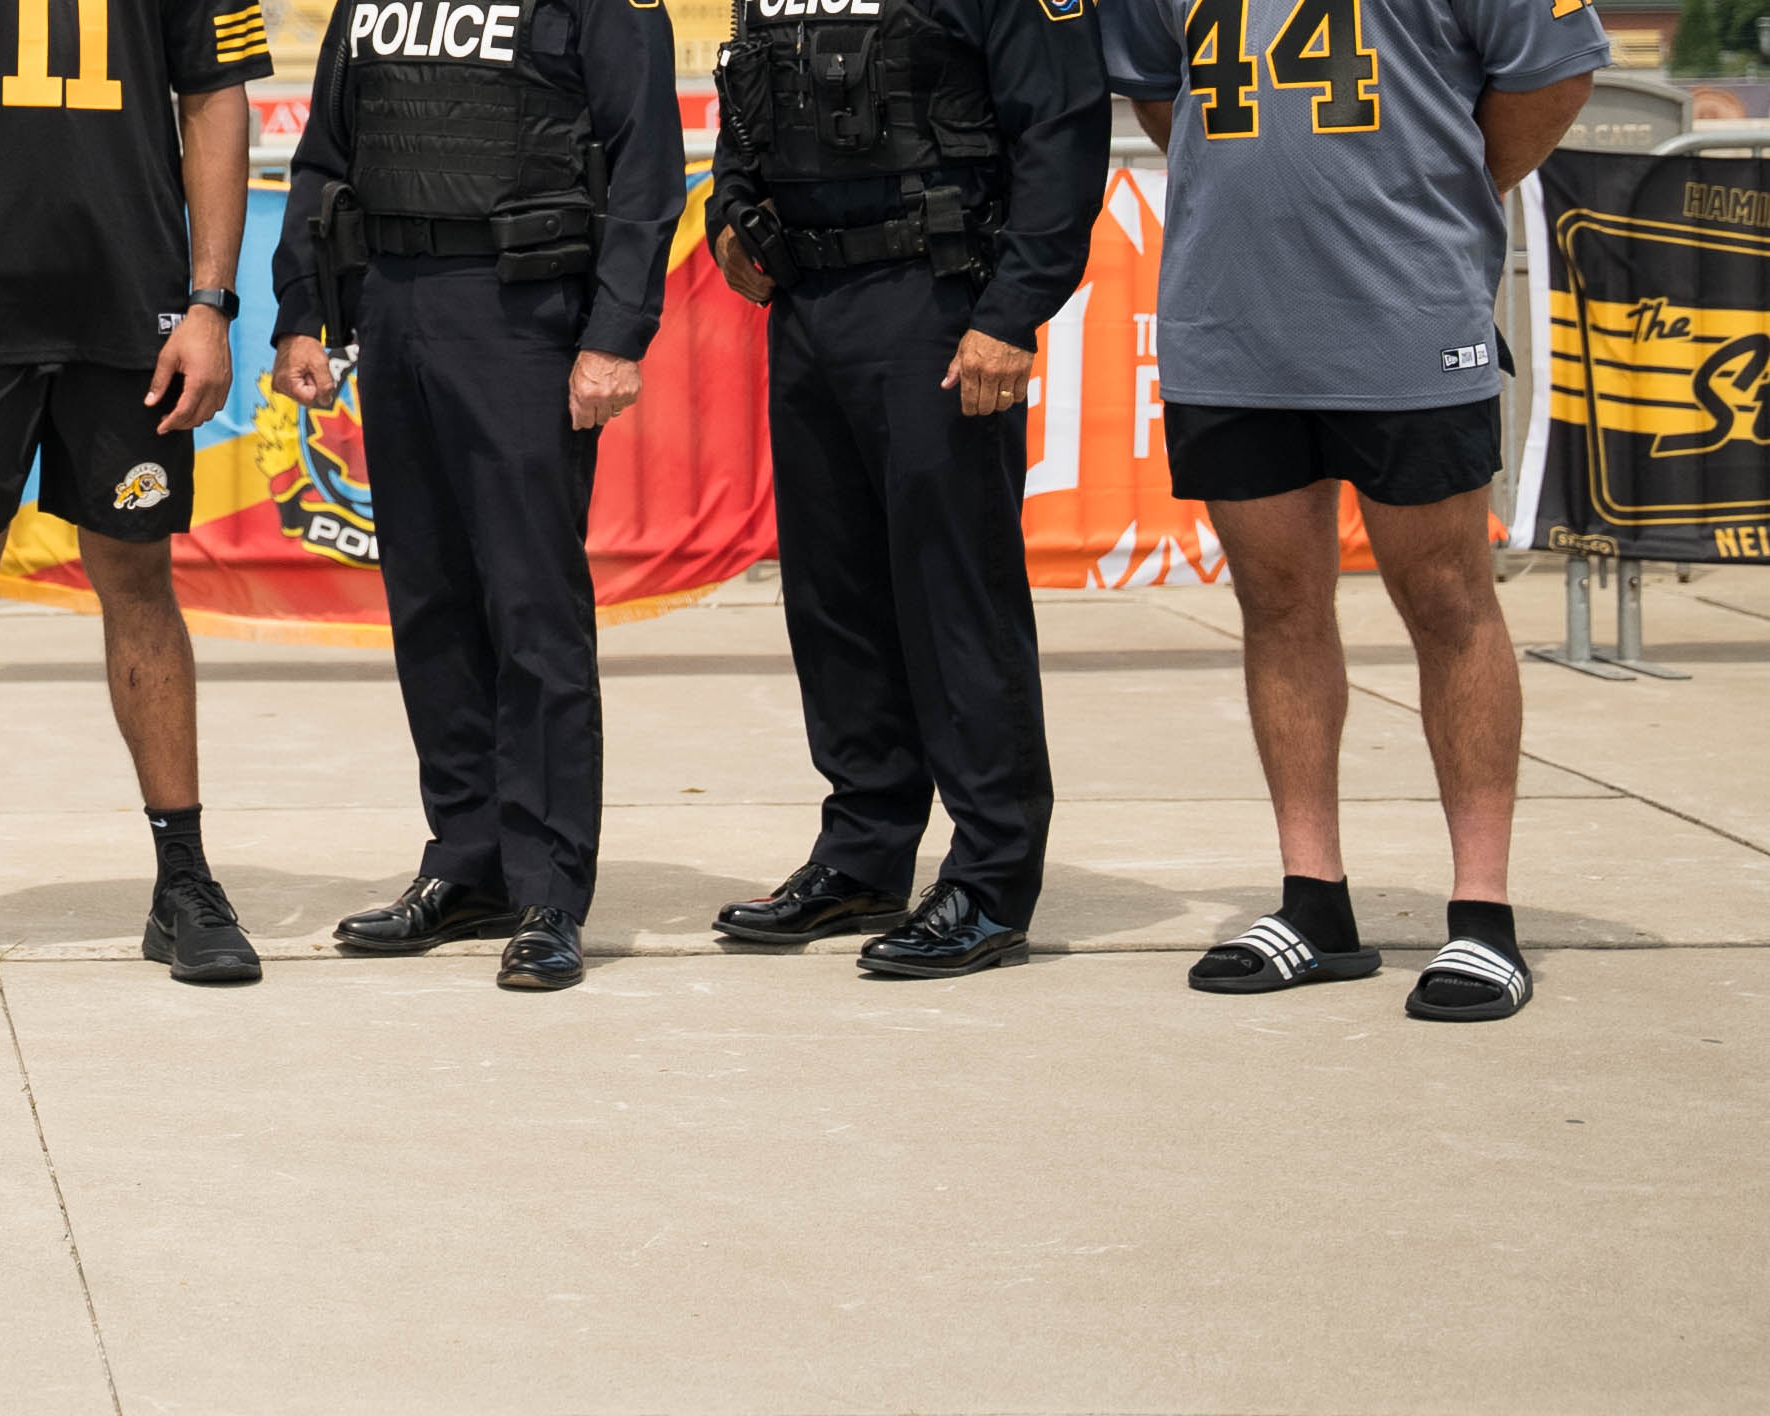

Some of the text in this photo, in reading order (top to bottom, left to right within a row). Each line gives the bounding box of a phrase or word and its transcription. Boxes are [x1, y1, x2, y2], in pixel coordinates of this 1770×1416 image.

[350, 0, 521, 62] POLICE
[1683, 181, 1770, 229] HAMI
[1626, 297, 1693, 345] The
